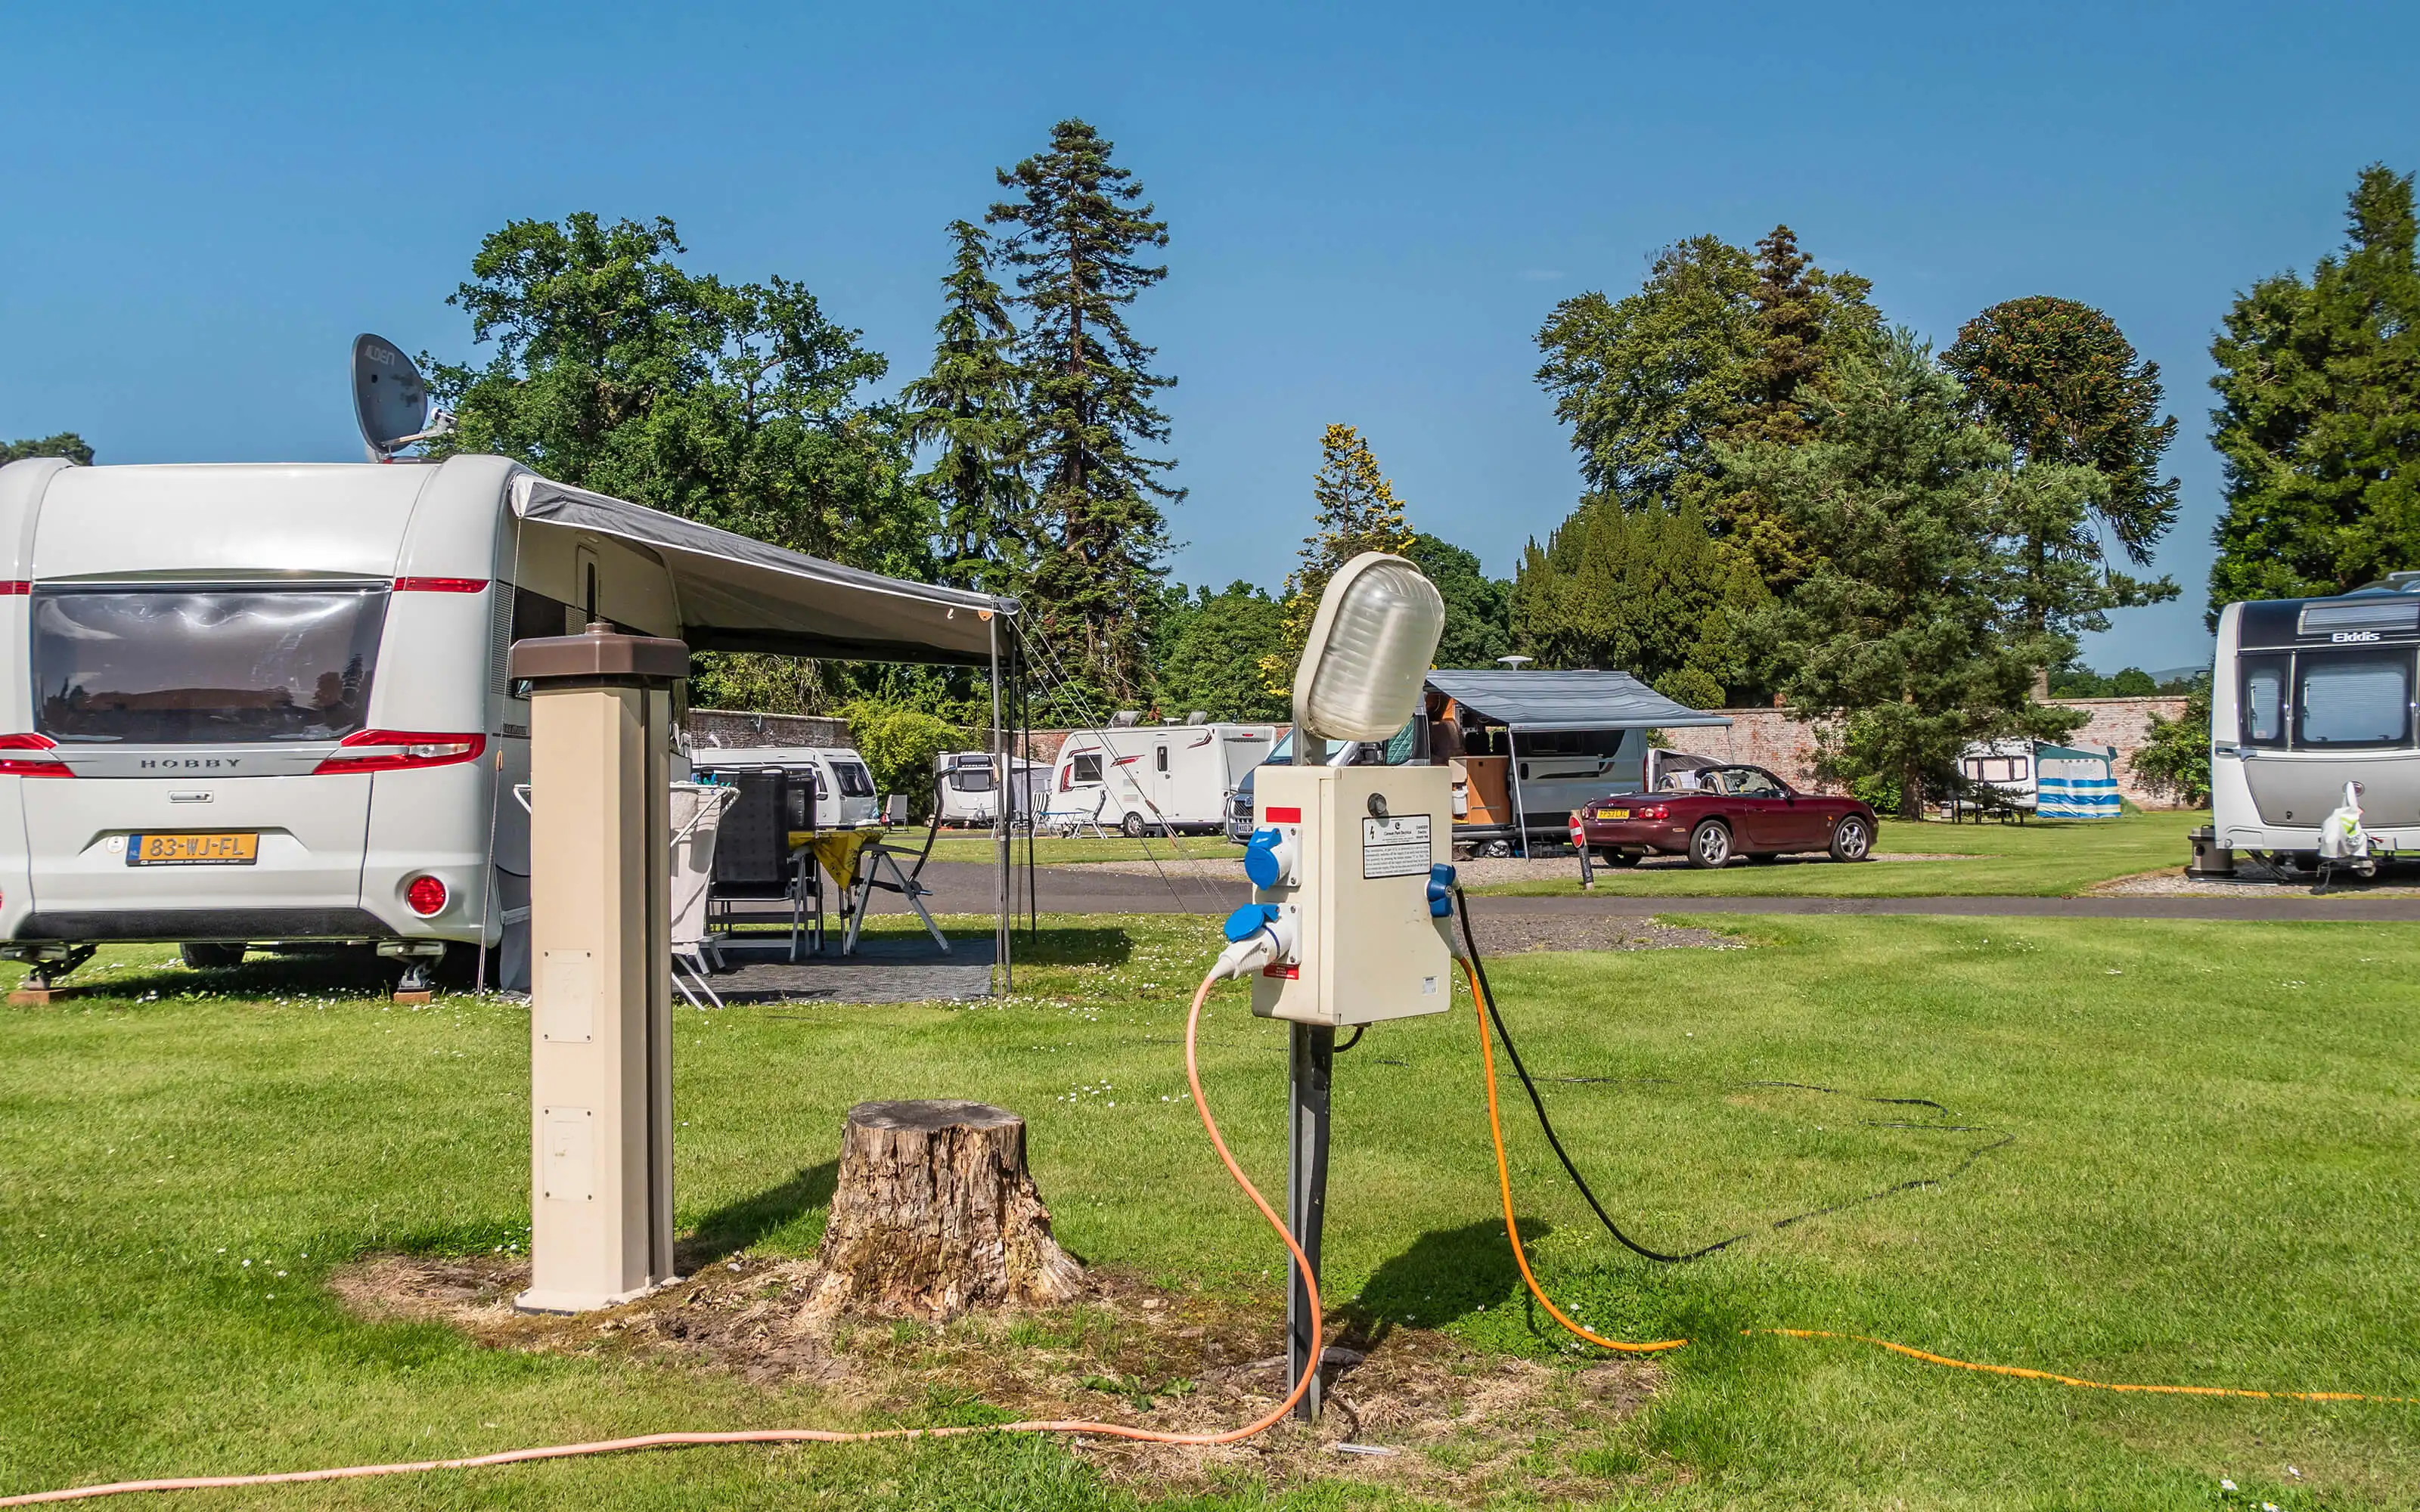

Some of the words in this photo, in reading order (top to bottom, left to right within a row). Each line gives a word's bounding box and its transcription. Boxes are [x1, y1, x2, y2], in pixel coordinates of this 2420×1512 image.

[364, 345, 396, 367] ALDEN
[2332, 631, 2381, 643] Elddis
[141, 758, 241, 768] HOBBY
[150, 838, 244, 857] 83-WJ-FL
